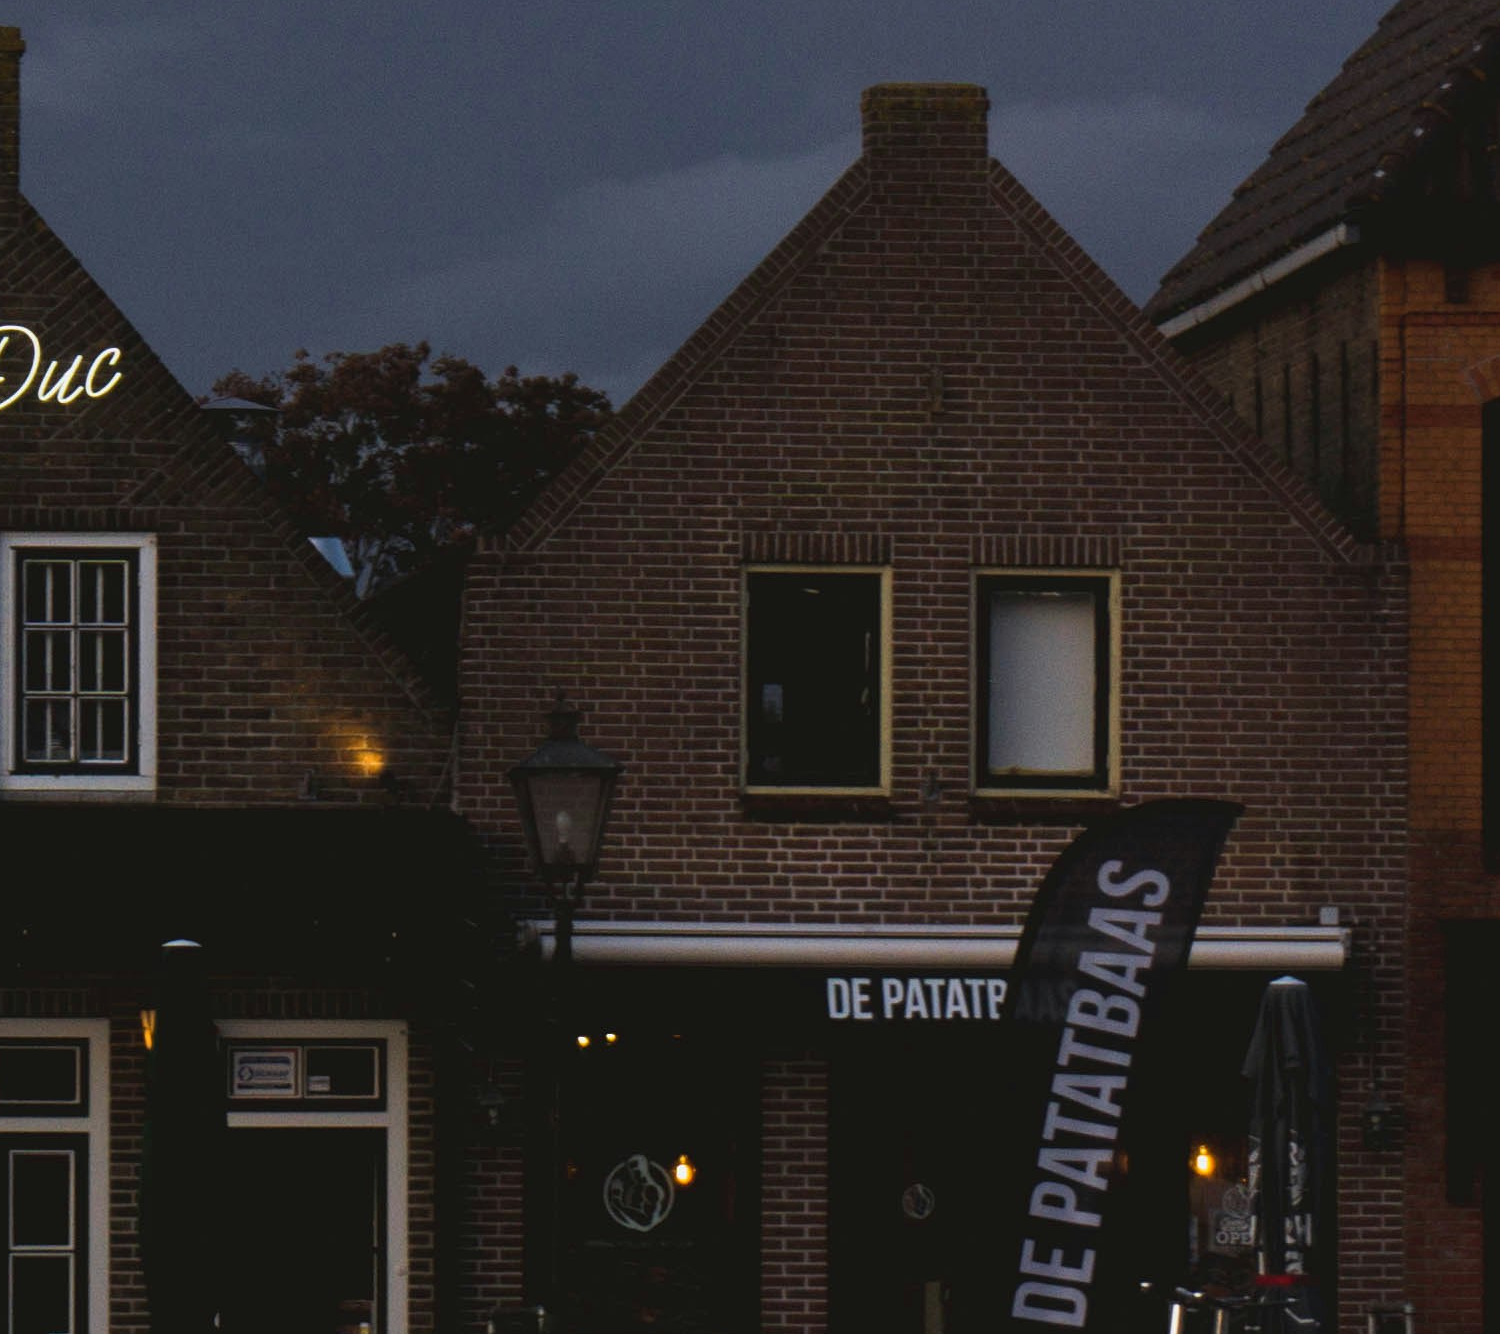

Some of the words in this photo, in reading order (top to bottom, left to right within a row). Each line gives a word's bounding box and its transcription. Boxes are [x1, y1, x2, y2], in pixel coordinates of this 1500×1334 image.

[826, 976, 873, 1020] DE
[1026, 858, 1172, 1229] PATATBAAS
[1215, 1231, 1252, 1244] OPE
[1010, 1237, 1097, 1329] DE
